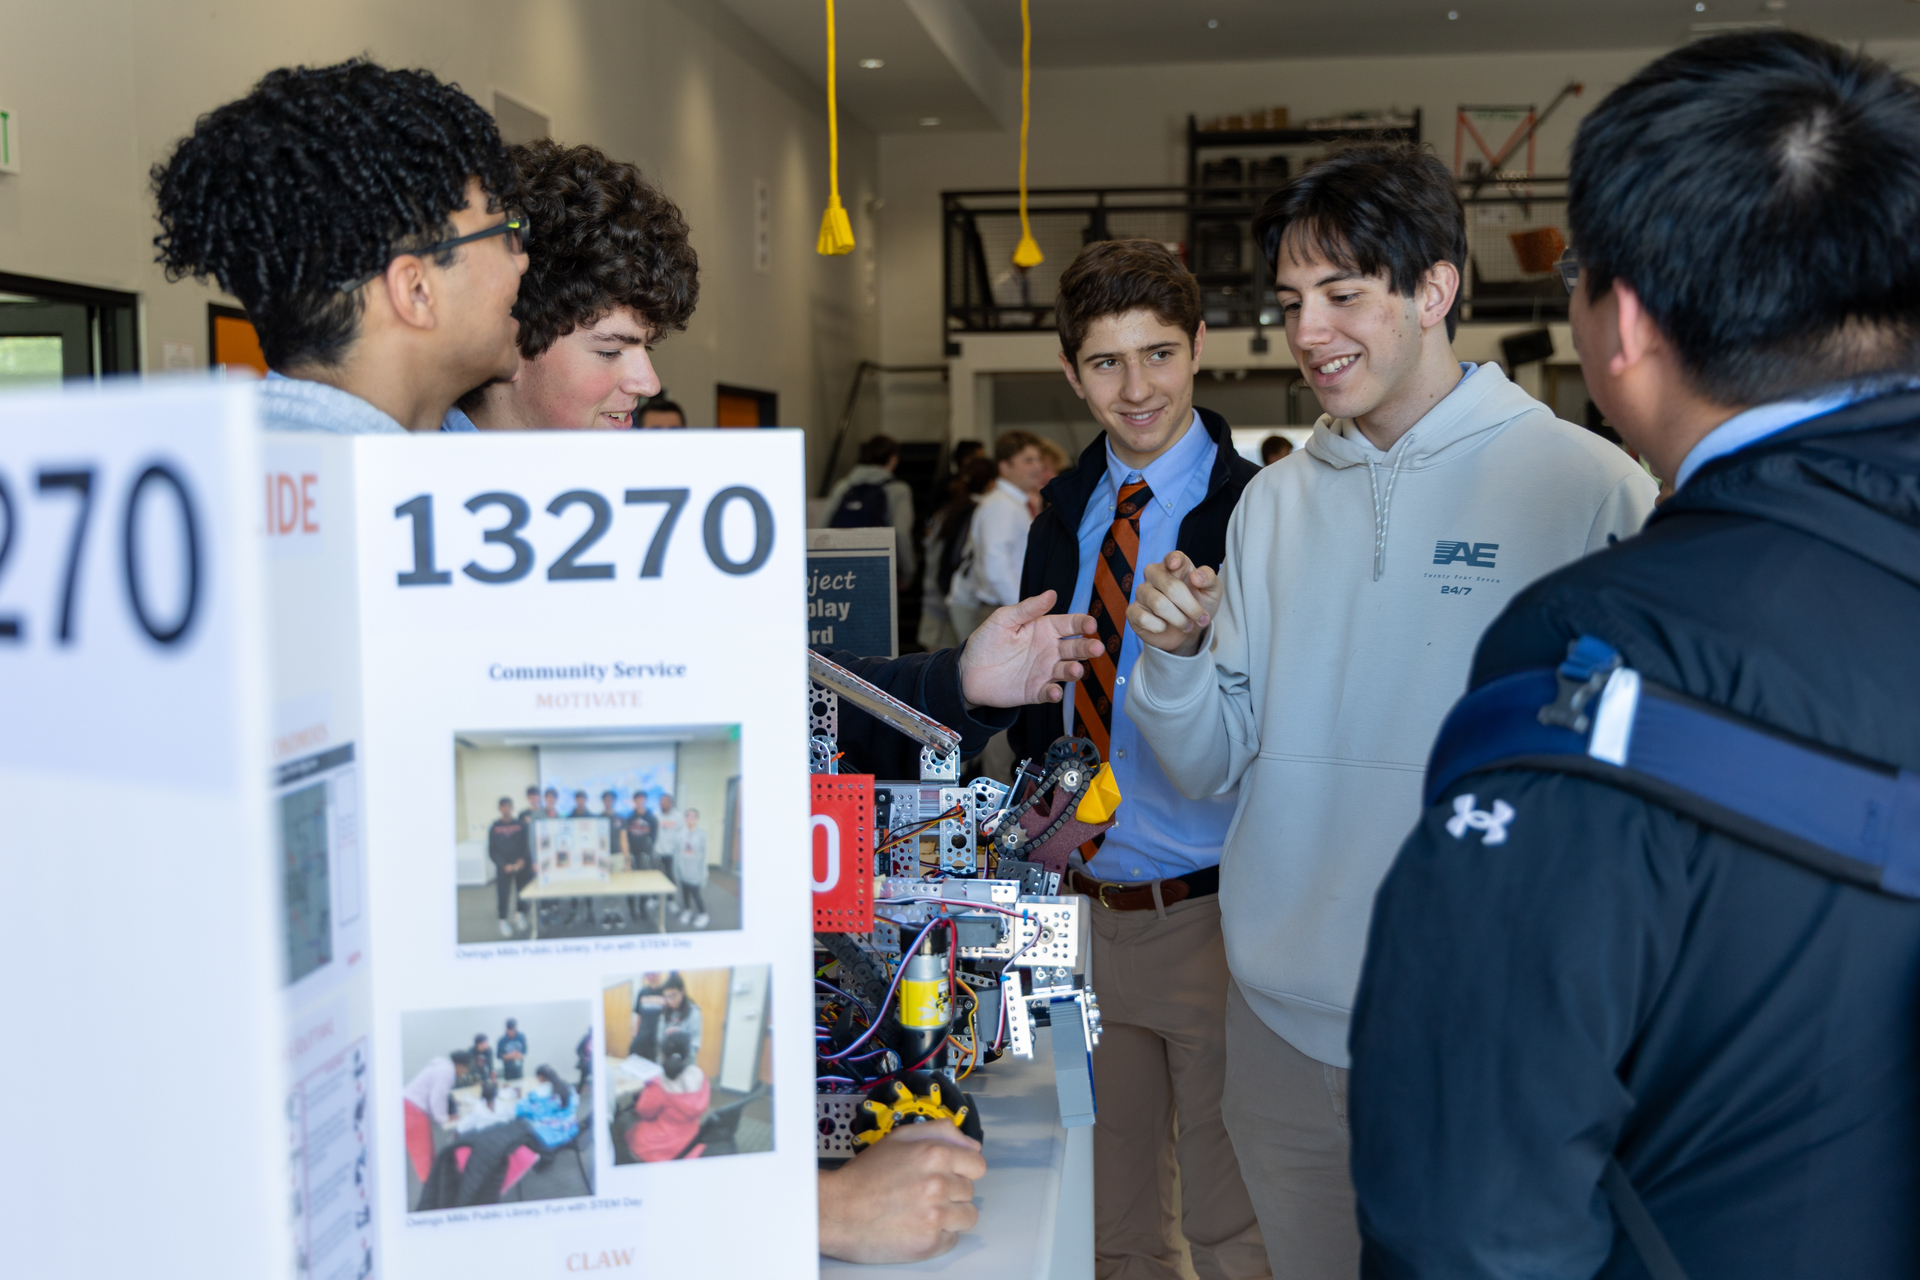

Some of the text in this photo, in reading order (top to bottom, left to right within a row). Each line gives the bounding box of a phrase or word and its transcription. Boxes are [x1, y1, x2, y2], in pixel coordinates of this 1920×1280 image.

[394, 485, 776, 587] 13270
[0, 461, 203, 646] 70
[1440, 585, 1472, 595] 24/7
[488, 660, 687, 684] Community Service
[535, 691, 643, 709] MOTIVATE
[522, 945, 552, 955] Public
[595, 941, 615, 951] Fun
[617, 940, 635, 949] with
[640, 939, 670, 949] STEM
[673, 938, 692, 949] Day
[472, 1210, 502, 1221] Public
[545, 1204, 565, 1214] Fun
[567, 1202, 586, 1212] with
[590, 1199, 621, 1210] STEM
[623, 1197, 643, 1208] Day
[567, 1248, 635, 1271] CLAW
